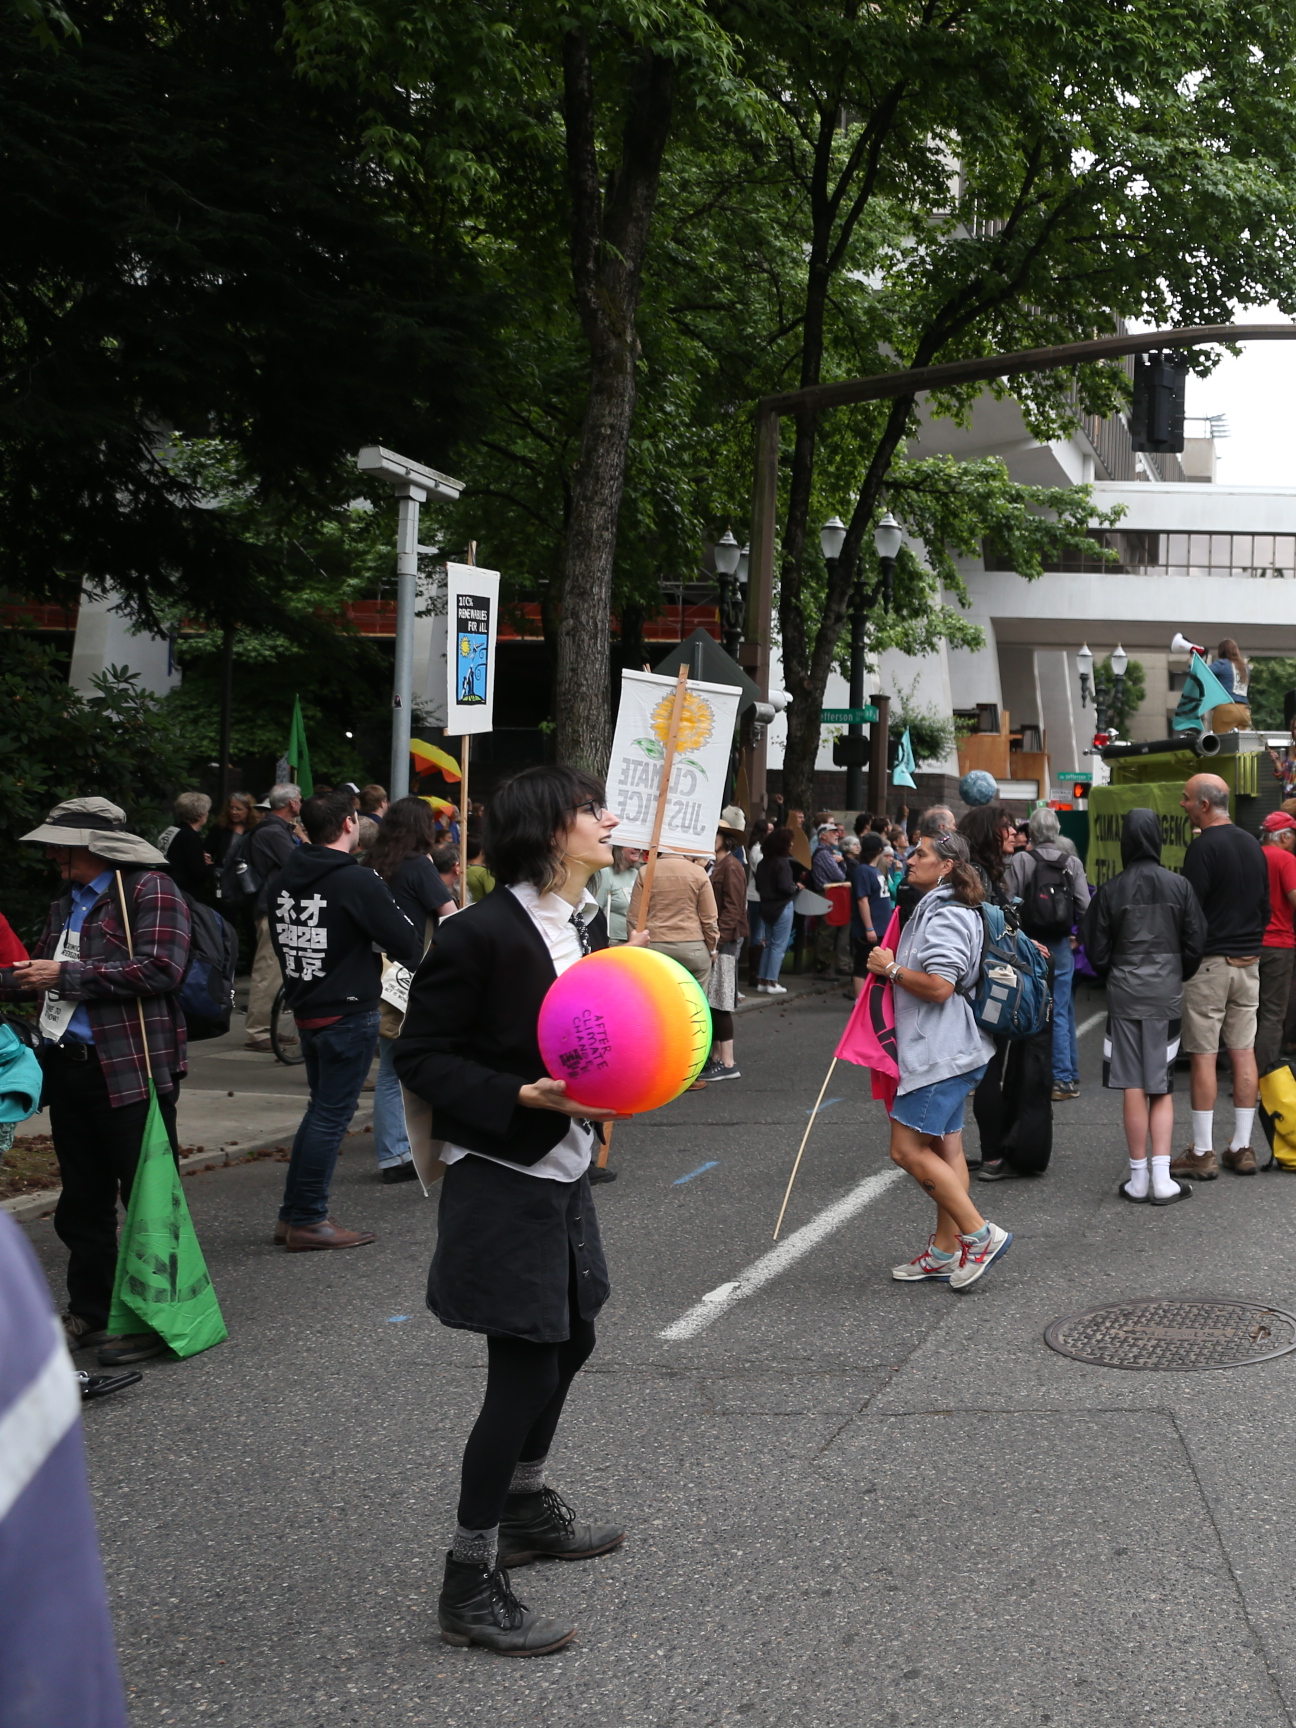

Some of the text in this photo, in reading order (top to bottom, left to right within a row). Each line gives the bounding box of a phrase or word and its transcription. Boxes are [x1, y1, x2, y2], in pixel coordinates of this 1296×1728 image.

[820, 711, 853, 722] efferson
[275, 890, 328, 926] ネオ
[572, 1016, 594, 1067] CHANGE
[582, 1009, 609, 1071] CLIMATE
[594, 1015, 612, 1055] AFTER
[677, 981, 708, 1082] EARTH
